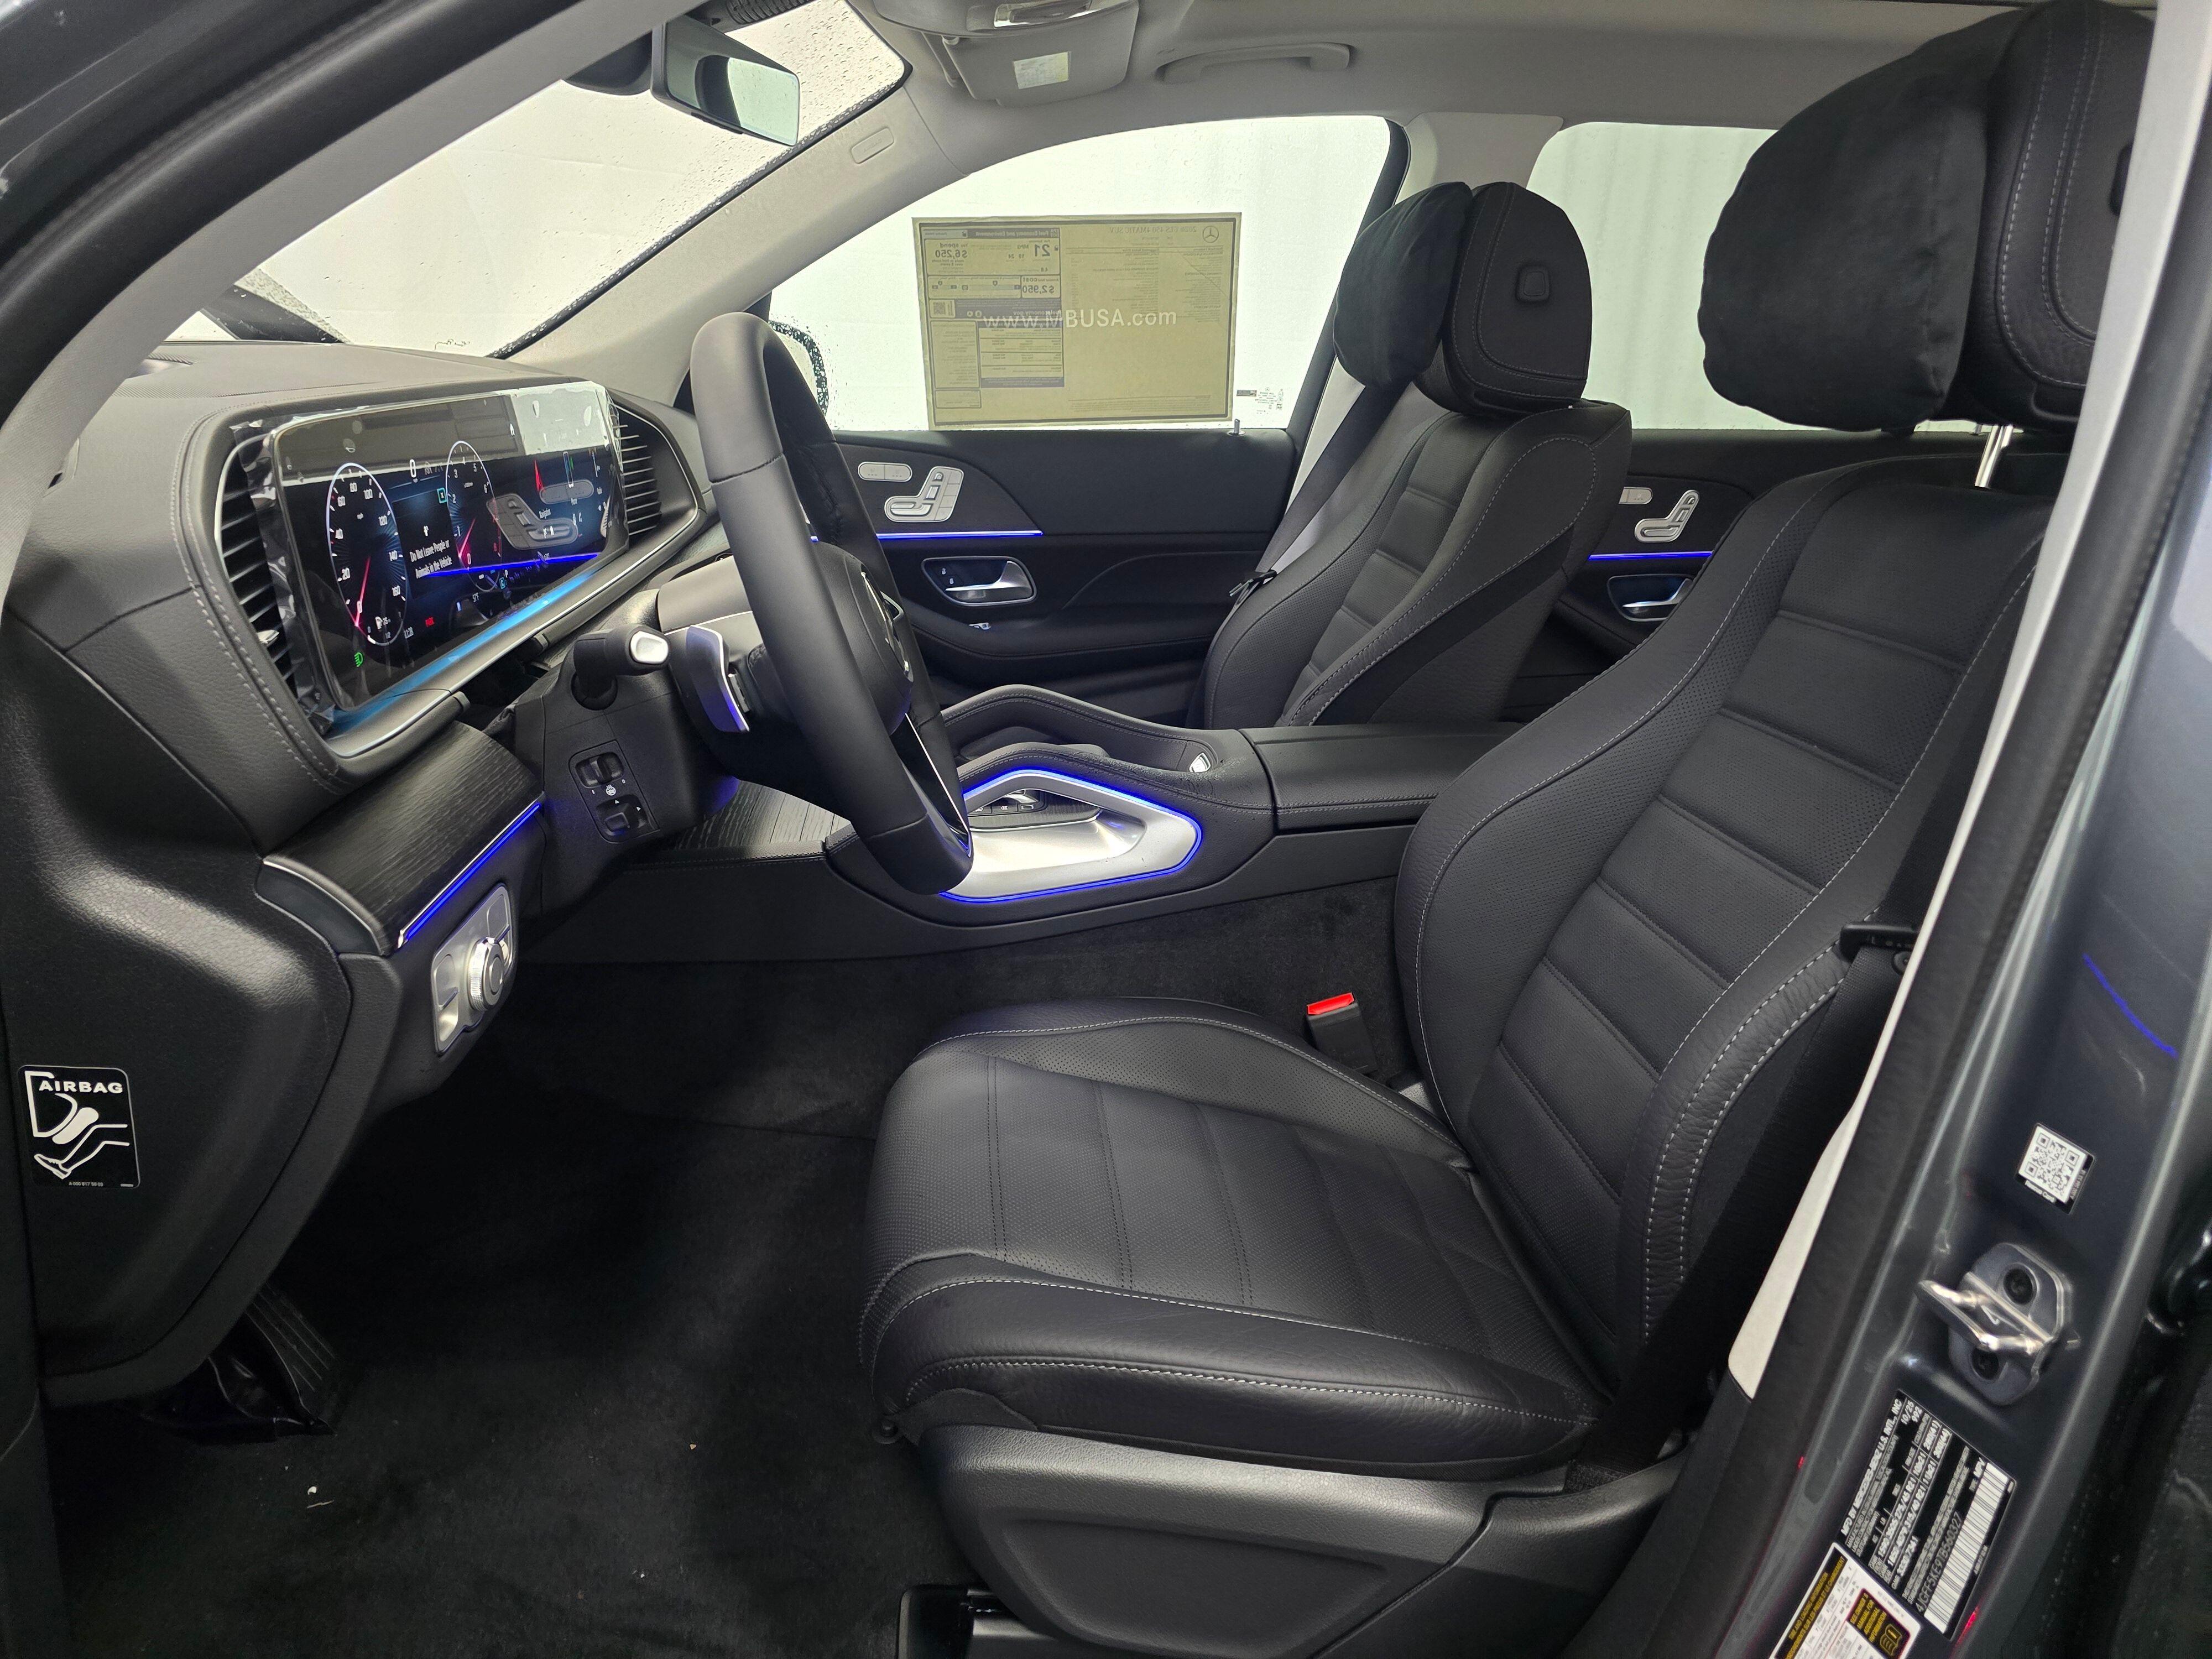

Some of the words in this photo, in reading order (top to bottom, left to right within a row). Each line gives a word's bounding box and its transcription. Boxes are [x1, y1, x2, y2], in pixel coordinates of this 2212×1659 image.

[349, 482, 357, 493] 80
[363, 488, 373, 499] 100
[378, 515, 388, 526] 120
[388, 550, 398, 561] 140
[341, 567, 351, 580] 20
[39, 1080, 123, 1094] AIRBAG
[1901, 1400, 1914, 1425] 10/25
[1911, 1406, 1922, 1422] 992
[1841, 1517, 1853, 1536] MFD
[1848, 1506, 1857, 1519] BY
[1853, 1449, 1882, 1509] MERCEDES-BENZ
[1891, 1399, 1902, 1415] INC
[1973, 1458, 1985, 1478] MPV
[1916, 1512, 1962, 1612] 4JGFF5KE9TB560327
